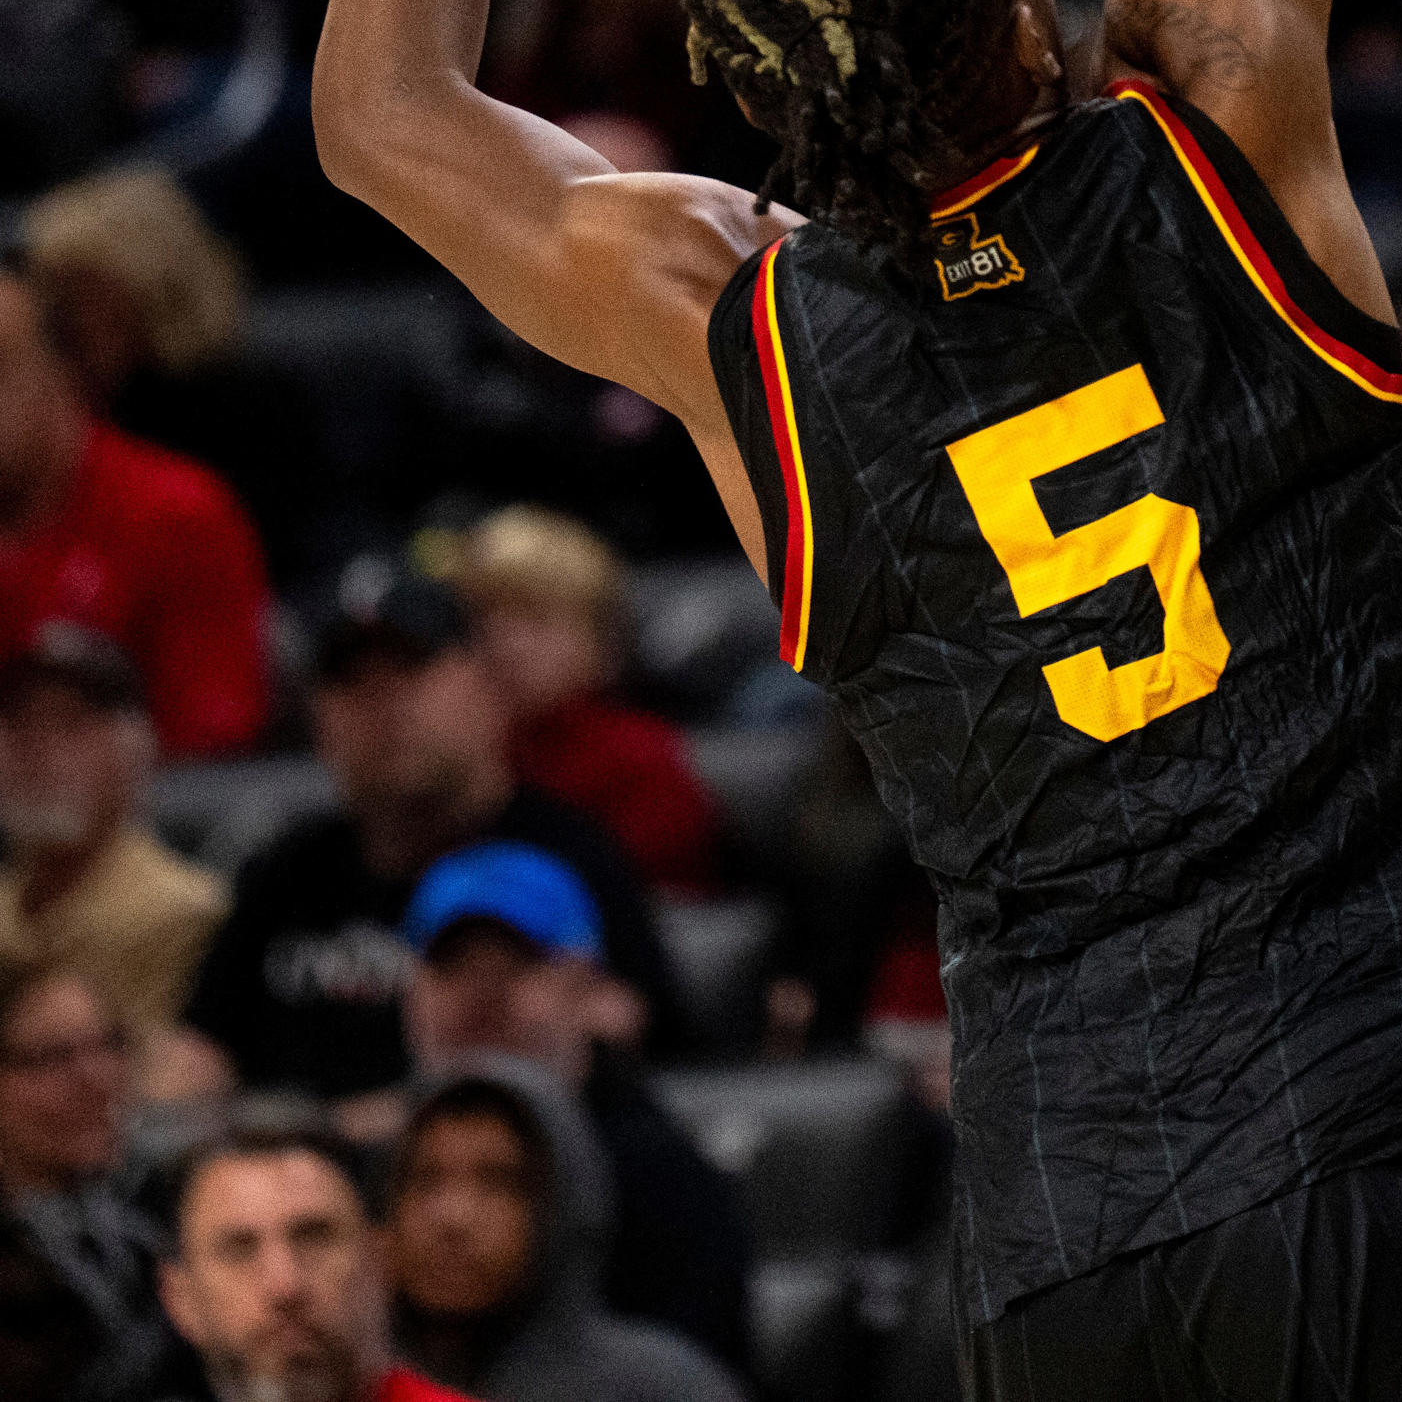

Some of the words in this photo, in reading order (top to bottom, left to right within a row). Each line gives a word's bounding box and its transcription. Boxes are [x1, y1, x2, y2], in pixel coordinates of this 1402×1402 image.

[945, 259, 973, 283] EXIT
[970, 245, 1004, 276] 81
[945, 363, 1231, 743] 5
